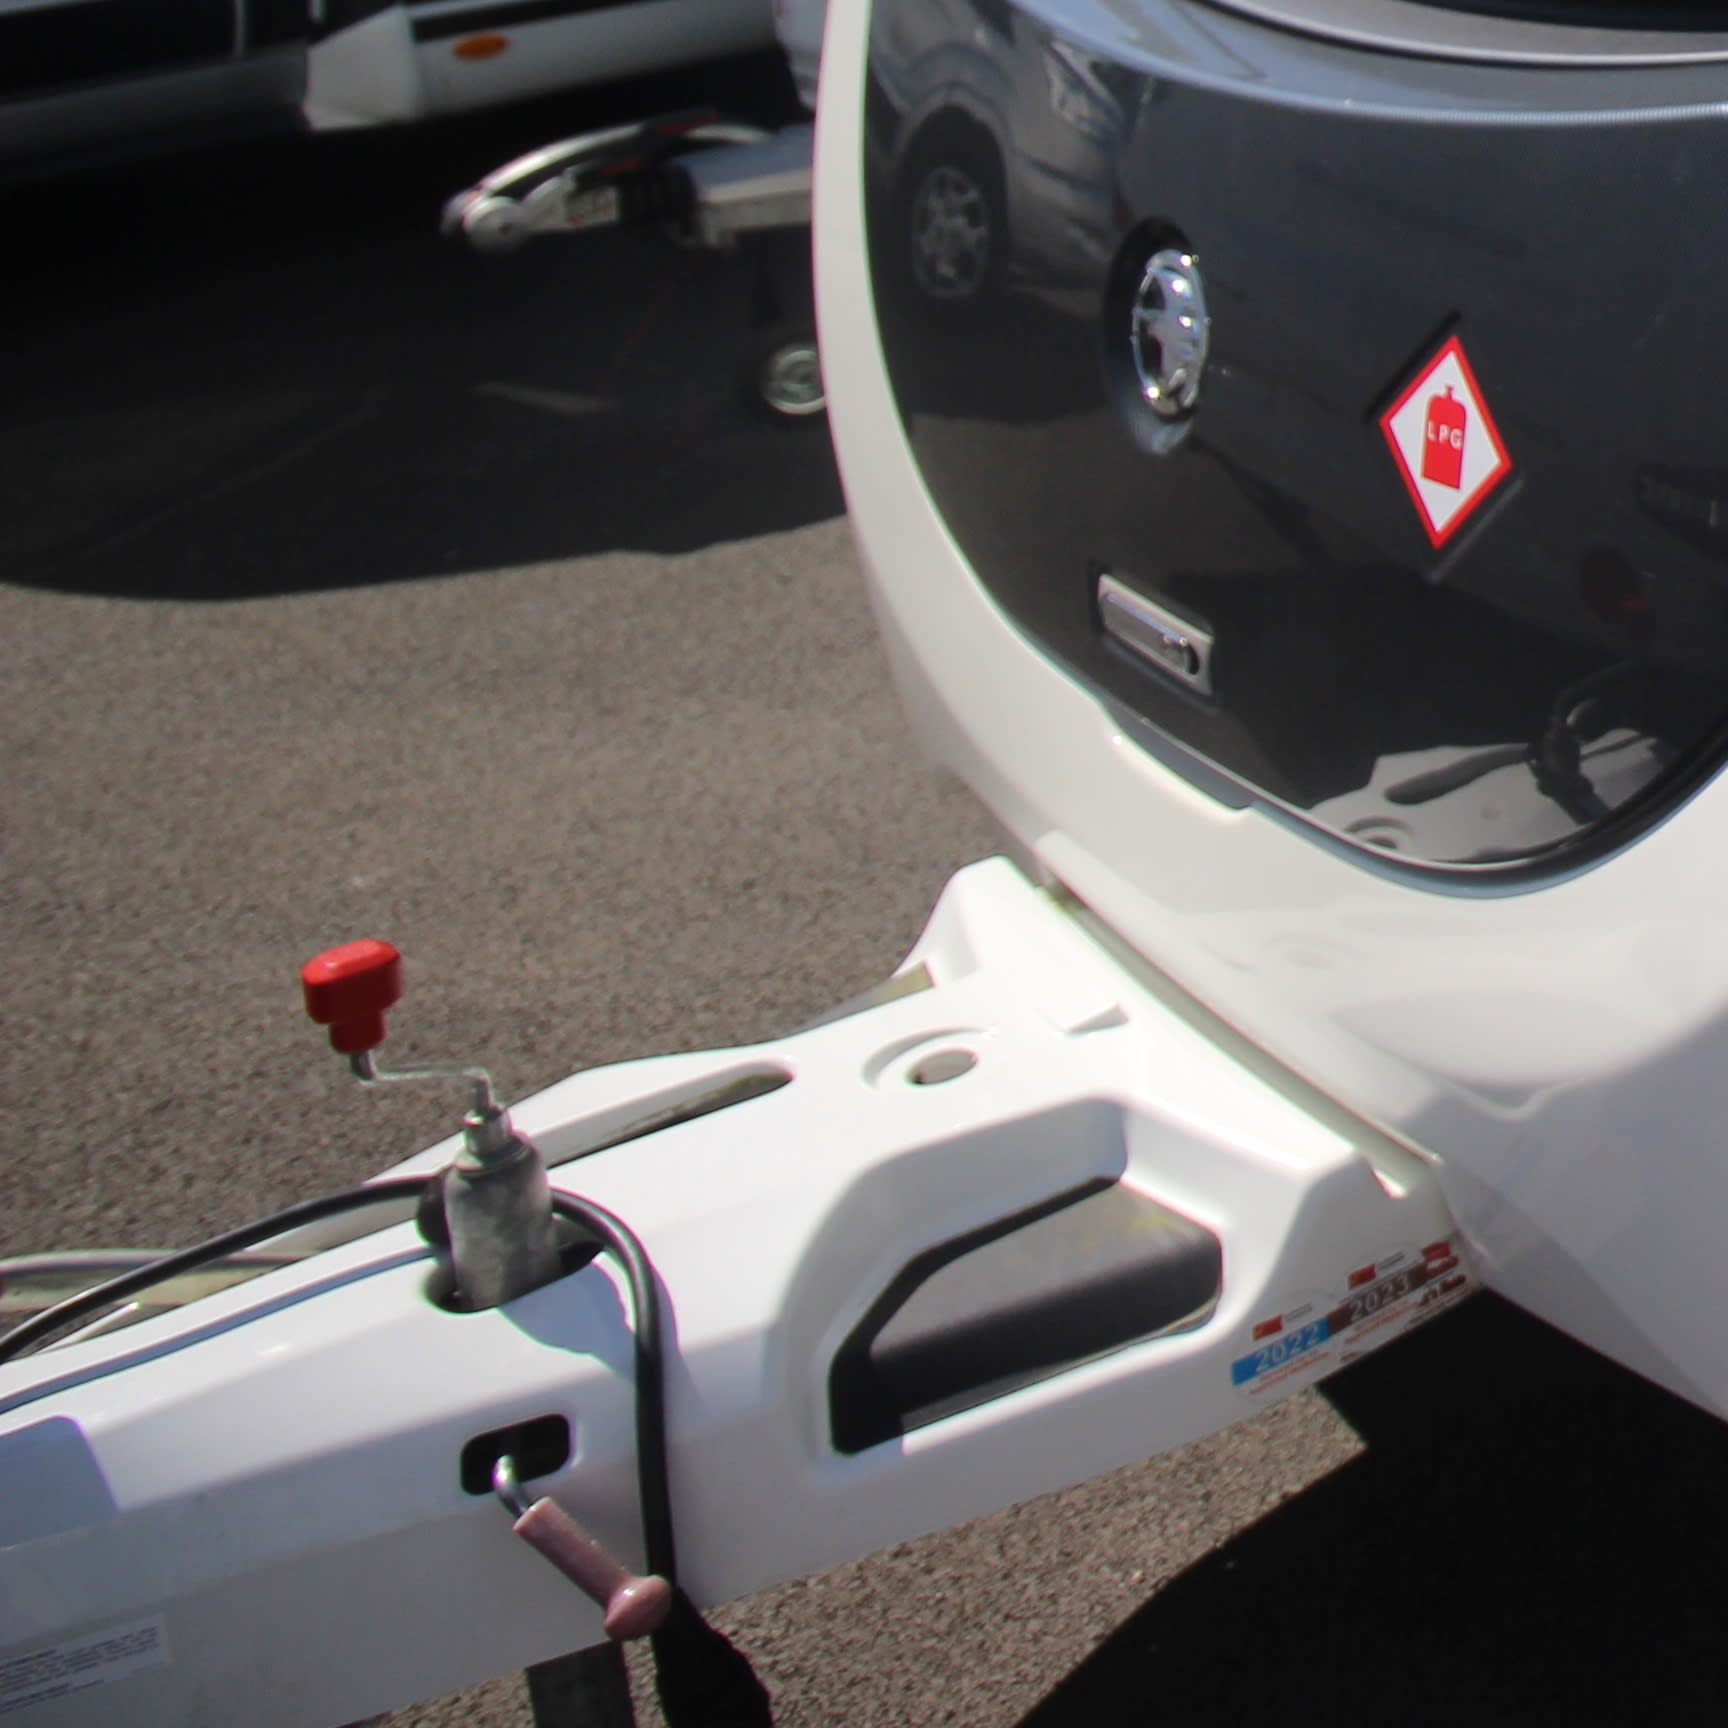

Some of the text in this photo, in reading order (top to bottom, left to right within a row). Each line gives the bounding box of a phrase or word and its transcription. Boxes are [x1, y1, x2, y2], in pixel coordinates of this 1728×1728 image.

[1427, 421, 1463, 449] LPG
[1350, 1274, 1410, 1321] 2023
[1256, 1324, 1319, 1372] 2022
